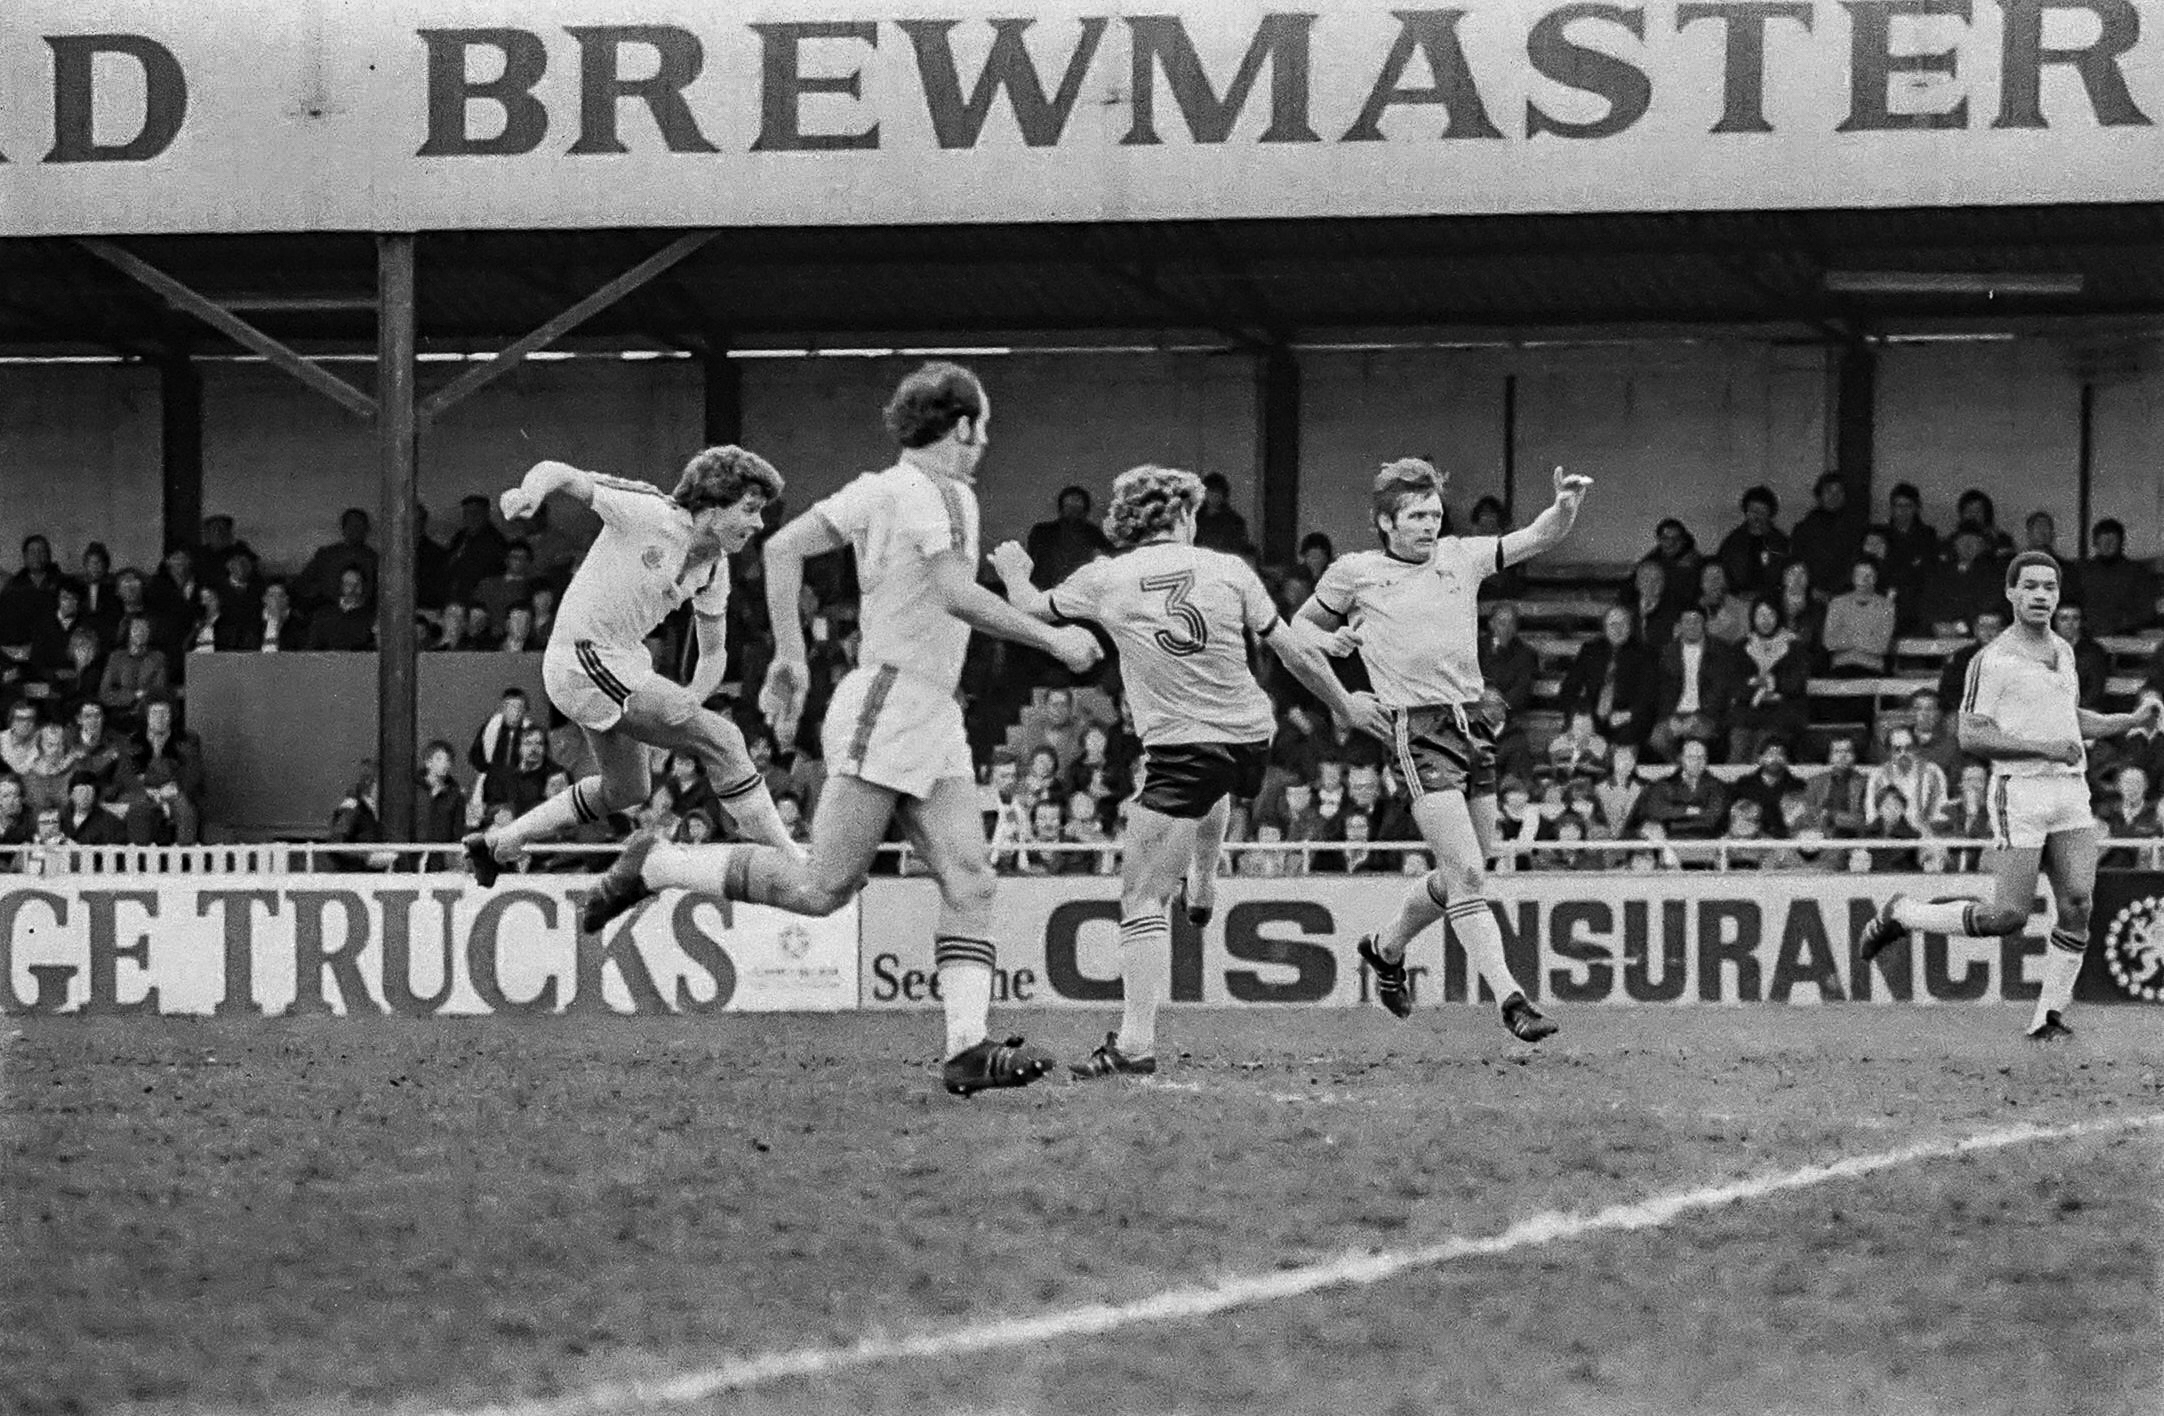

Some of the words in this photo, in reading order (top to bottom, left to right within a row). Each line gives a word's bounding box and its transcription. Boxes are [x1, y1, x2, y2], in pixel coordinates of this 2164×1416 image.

[0, 33, 188, 163] D
[415, 0, 2155, 157] BREWMASTER
[1139, 569, 1208, 657] 3
[197, 889, 738, 1013] TRUCKS
[1045, 899, 1337, 1001] CIS
[1445, 897, 2048, 1001] INSURANCE
